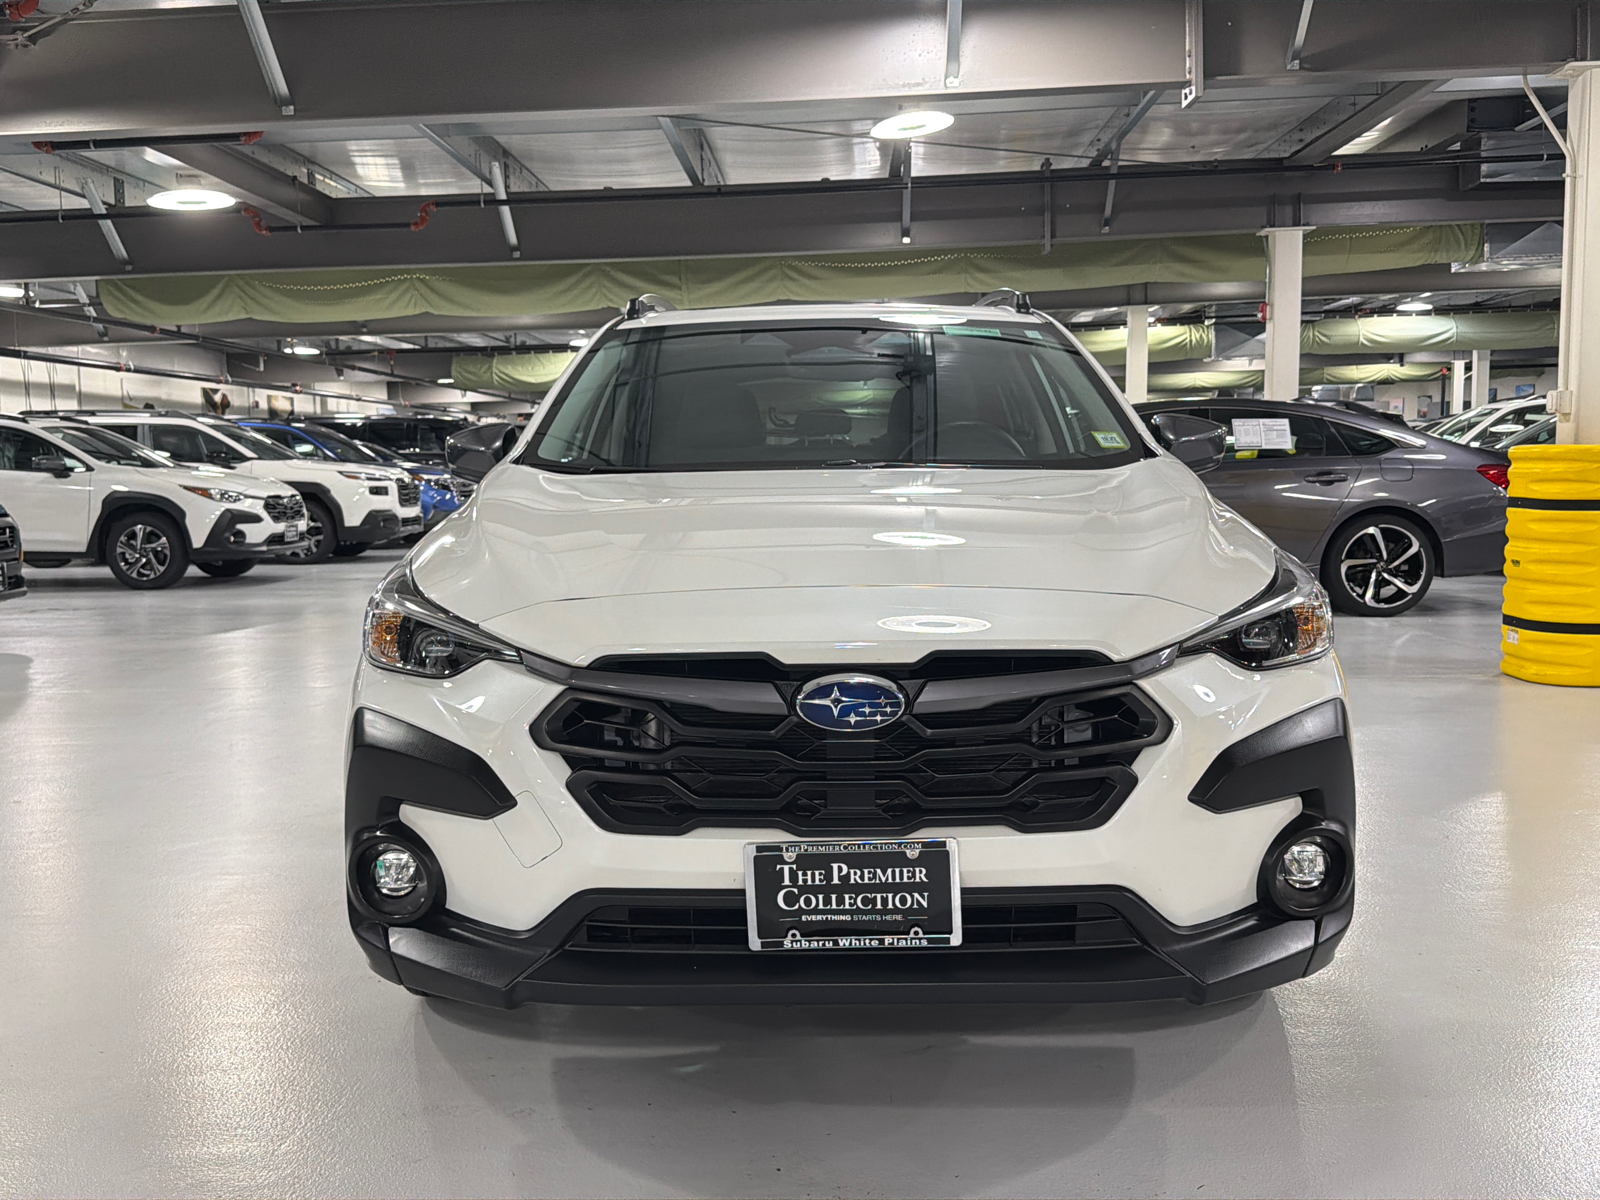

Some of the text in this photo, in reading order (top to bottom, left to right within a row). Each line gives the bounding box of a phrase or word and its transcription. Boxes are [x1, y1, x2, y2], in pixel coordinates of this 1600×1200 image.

[776, 862, 929, 886] THE PREMIER
[777, 887, 929, 911] COLLECTION
[801, 914, 852, 922] EVERYTHING
[783, 937, 929, 949] Subaru White Plains
